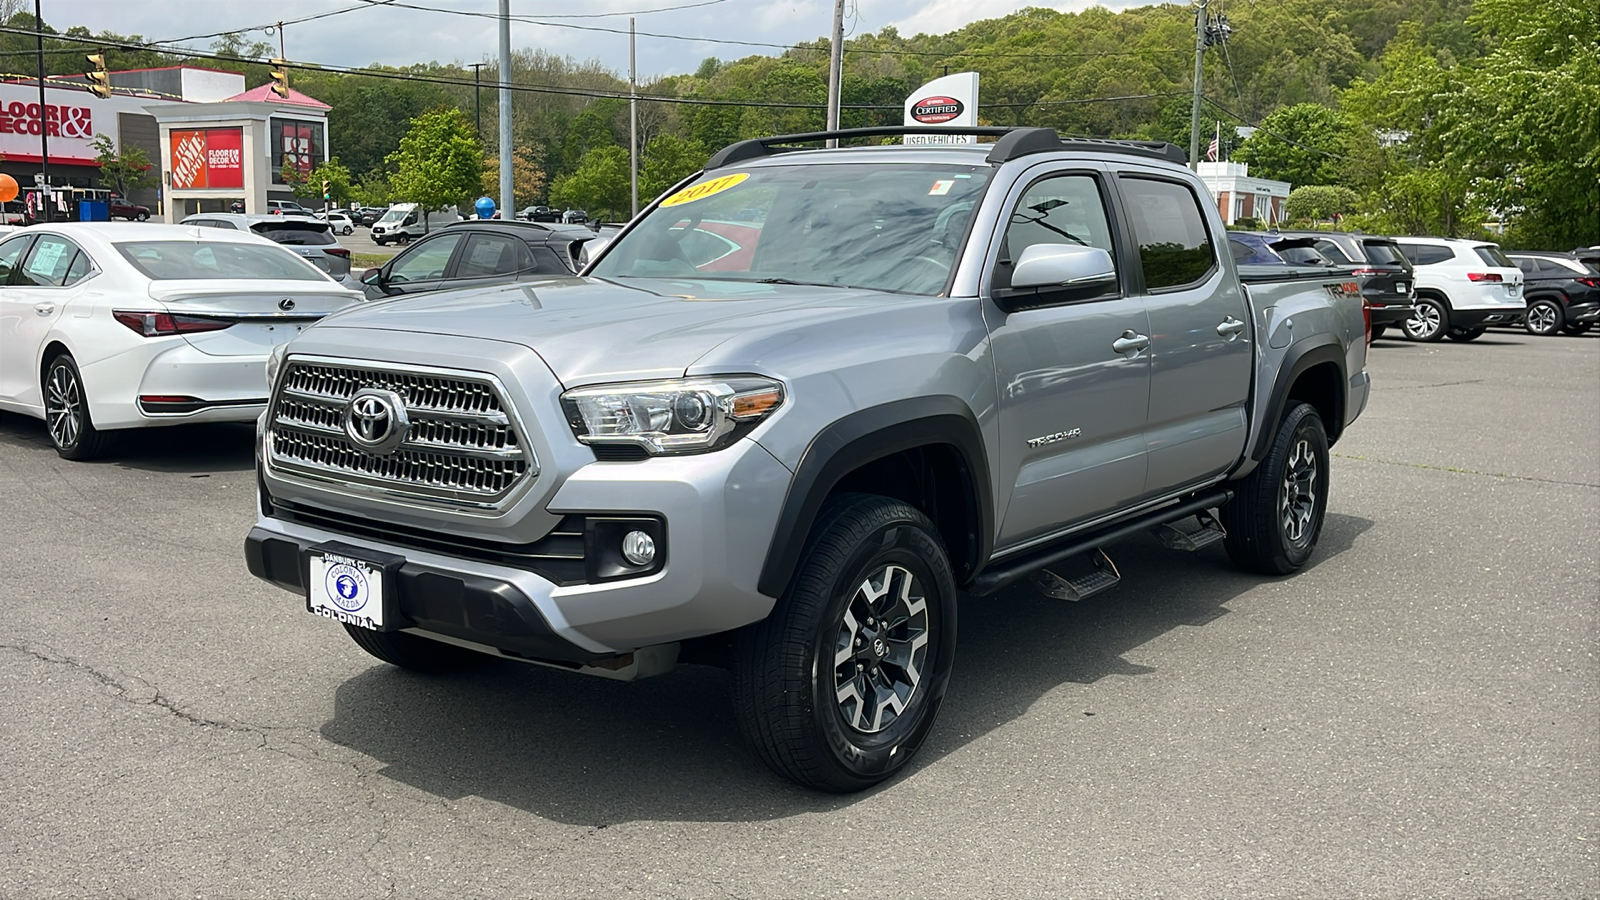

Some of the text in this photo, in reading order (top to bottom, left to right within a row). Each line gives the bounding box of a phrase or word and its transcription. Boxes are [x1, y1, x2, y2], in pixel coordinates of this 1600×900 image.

[916, 105, 957, 115] CERTIFIED
[172, 131, 206, 188] HOME
[184, 151, 206, 188] DEPOT
[671, 175, 736, 205] 2017
[1322, 283, 1345, 299] TRD
[1026, 427, 1082, 448] TACOMA
[330, 565, 364, 587] COLONIAL
[334, 594, 360, 609] MAZDA
[314, 606, 377, 631] COLONIAL
